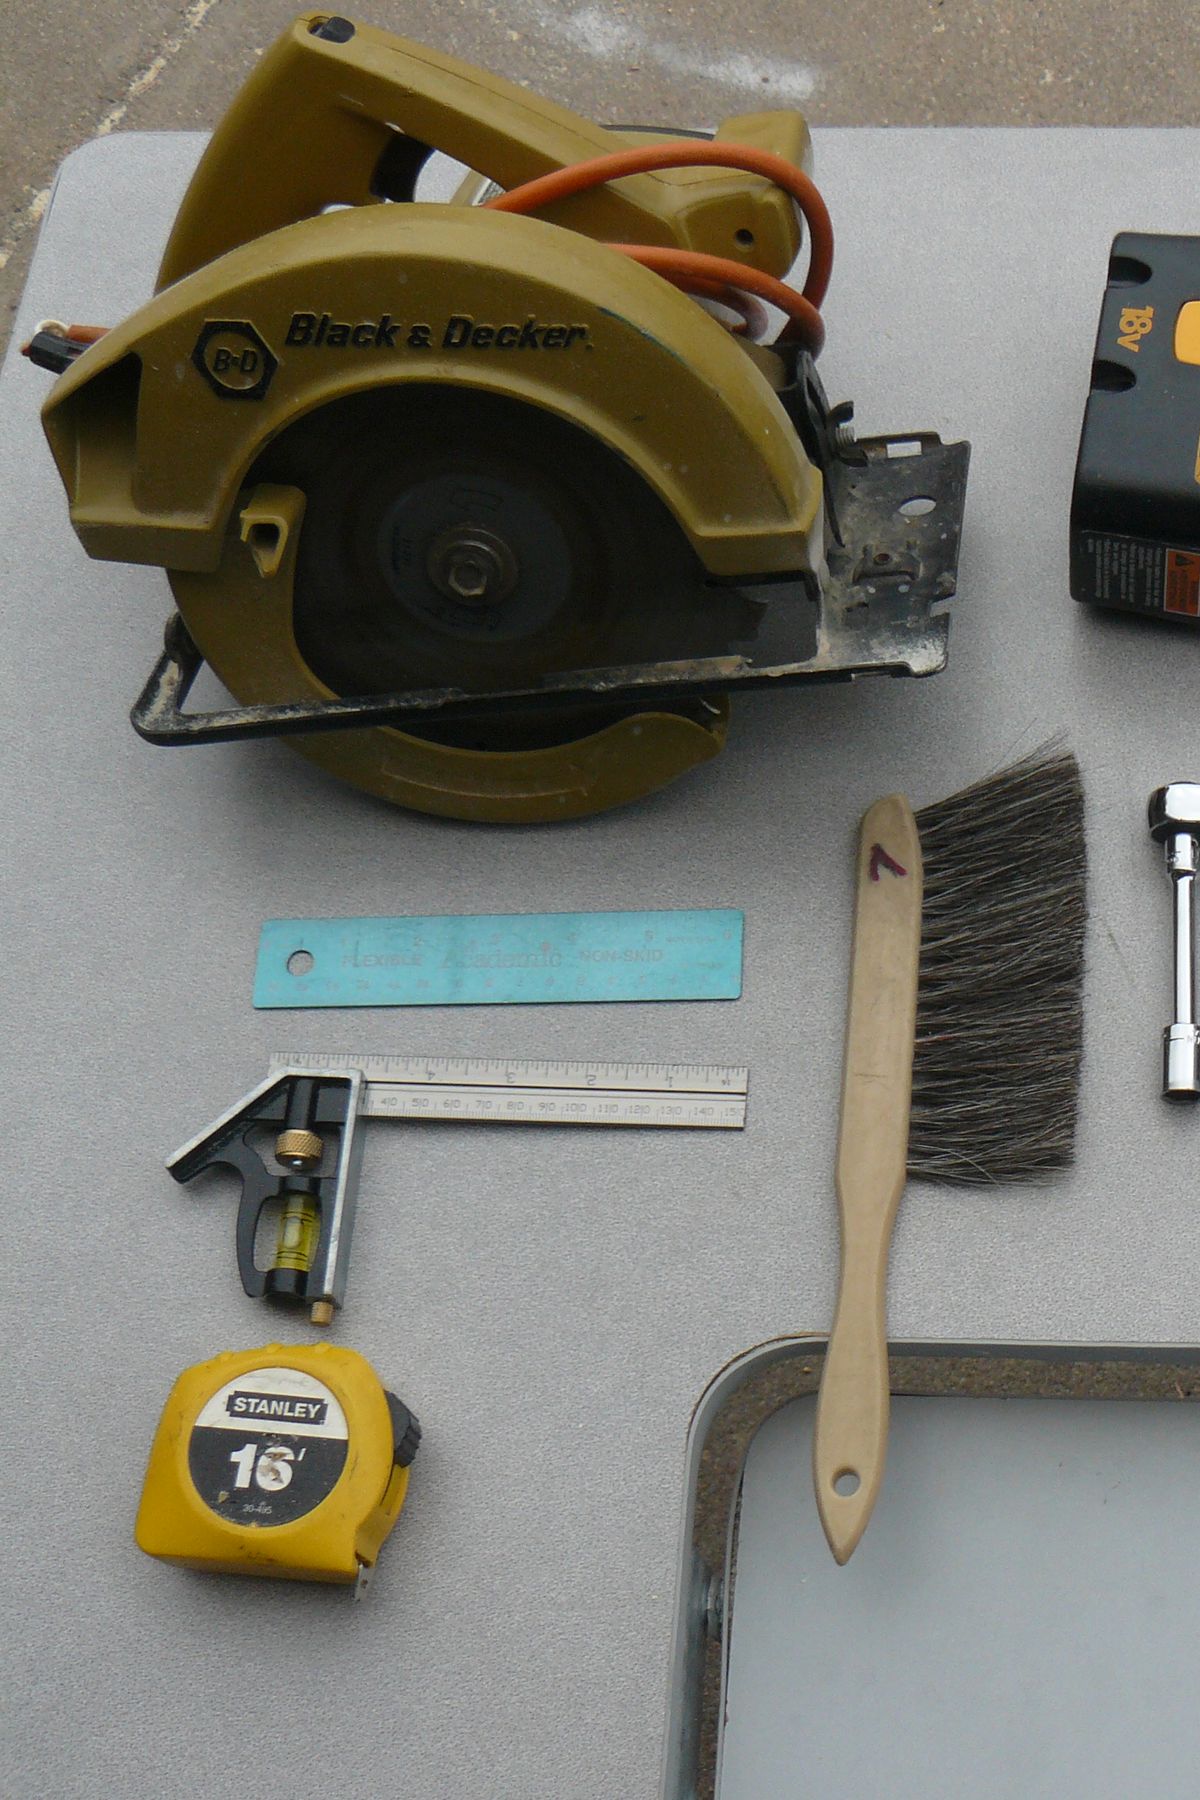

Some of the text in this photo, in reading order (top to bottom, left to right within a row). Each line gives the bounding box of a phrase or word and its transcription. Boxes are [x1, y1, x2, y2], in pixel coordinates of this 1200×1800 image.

[285, 311, 401, 348] Black
[406, 322, 433, 349] &
[504, 1071, 516, 1084] 3
[586, 1074, 598, 1086] 2
[380, 1097, 398, 1106] 40
[411, 1098, 429, 1107] 50
[443, 1099, 461, 1108] 60
[475, 1100, 493, 1109] 70
[506, 1101, 525, 1111] 80
[538, 1102, 556, 1112] 90
[565, 1103, 587, 1113] 100
[599, 1104, 619, 1114] 110
[628, 1105, 650, 1115] 120
[660, 1106, 683, 1116] 130
[693, 1107, 714, 1117] 140
[233, 1396, 322, 1420] STANLEY
